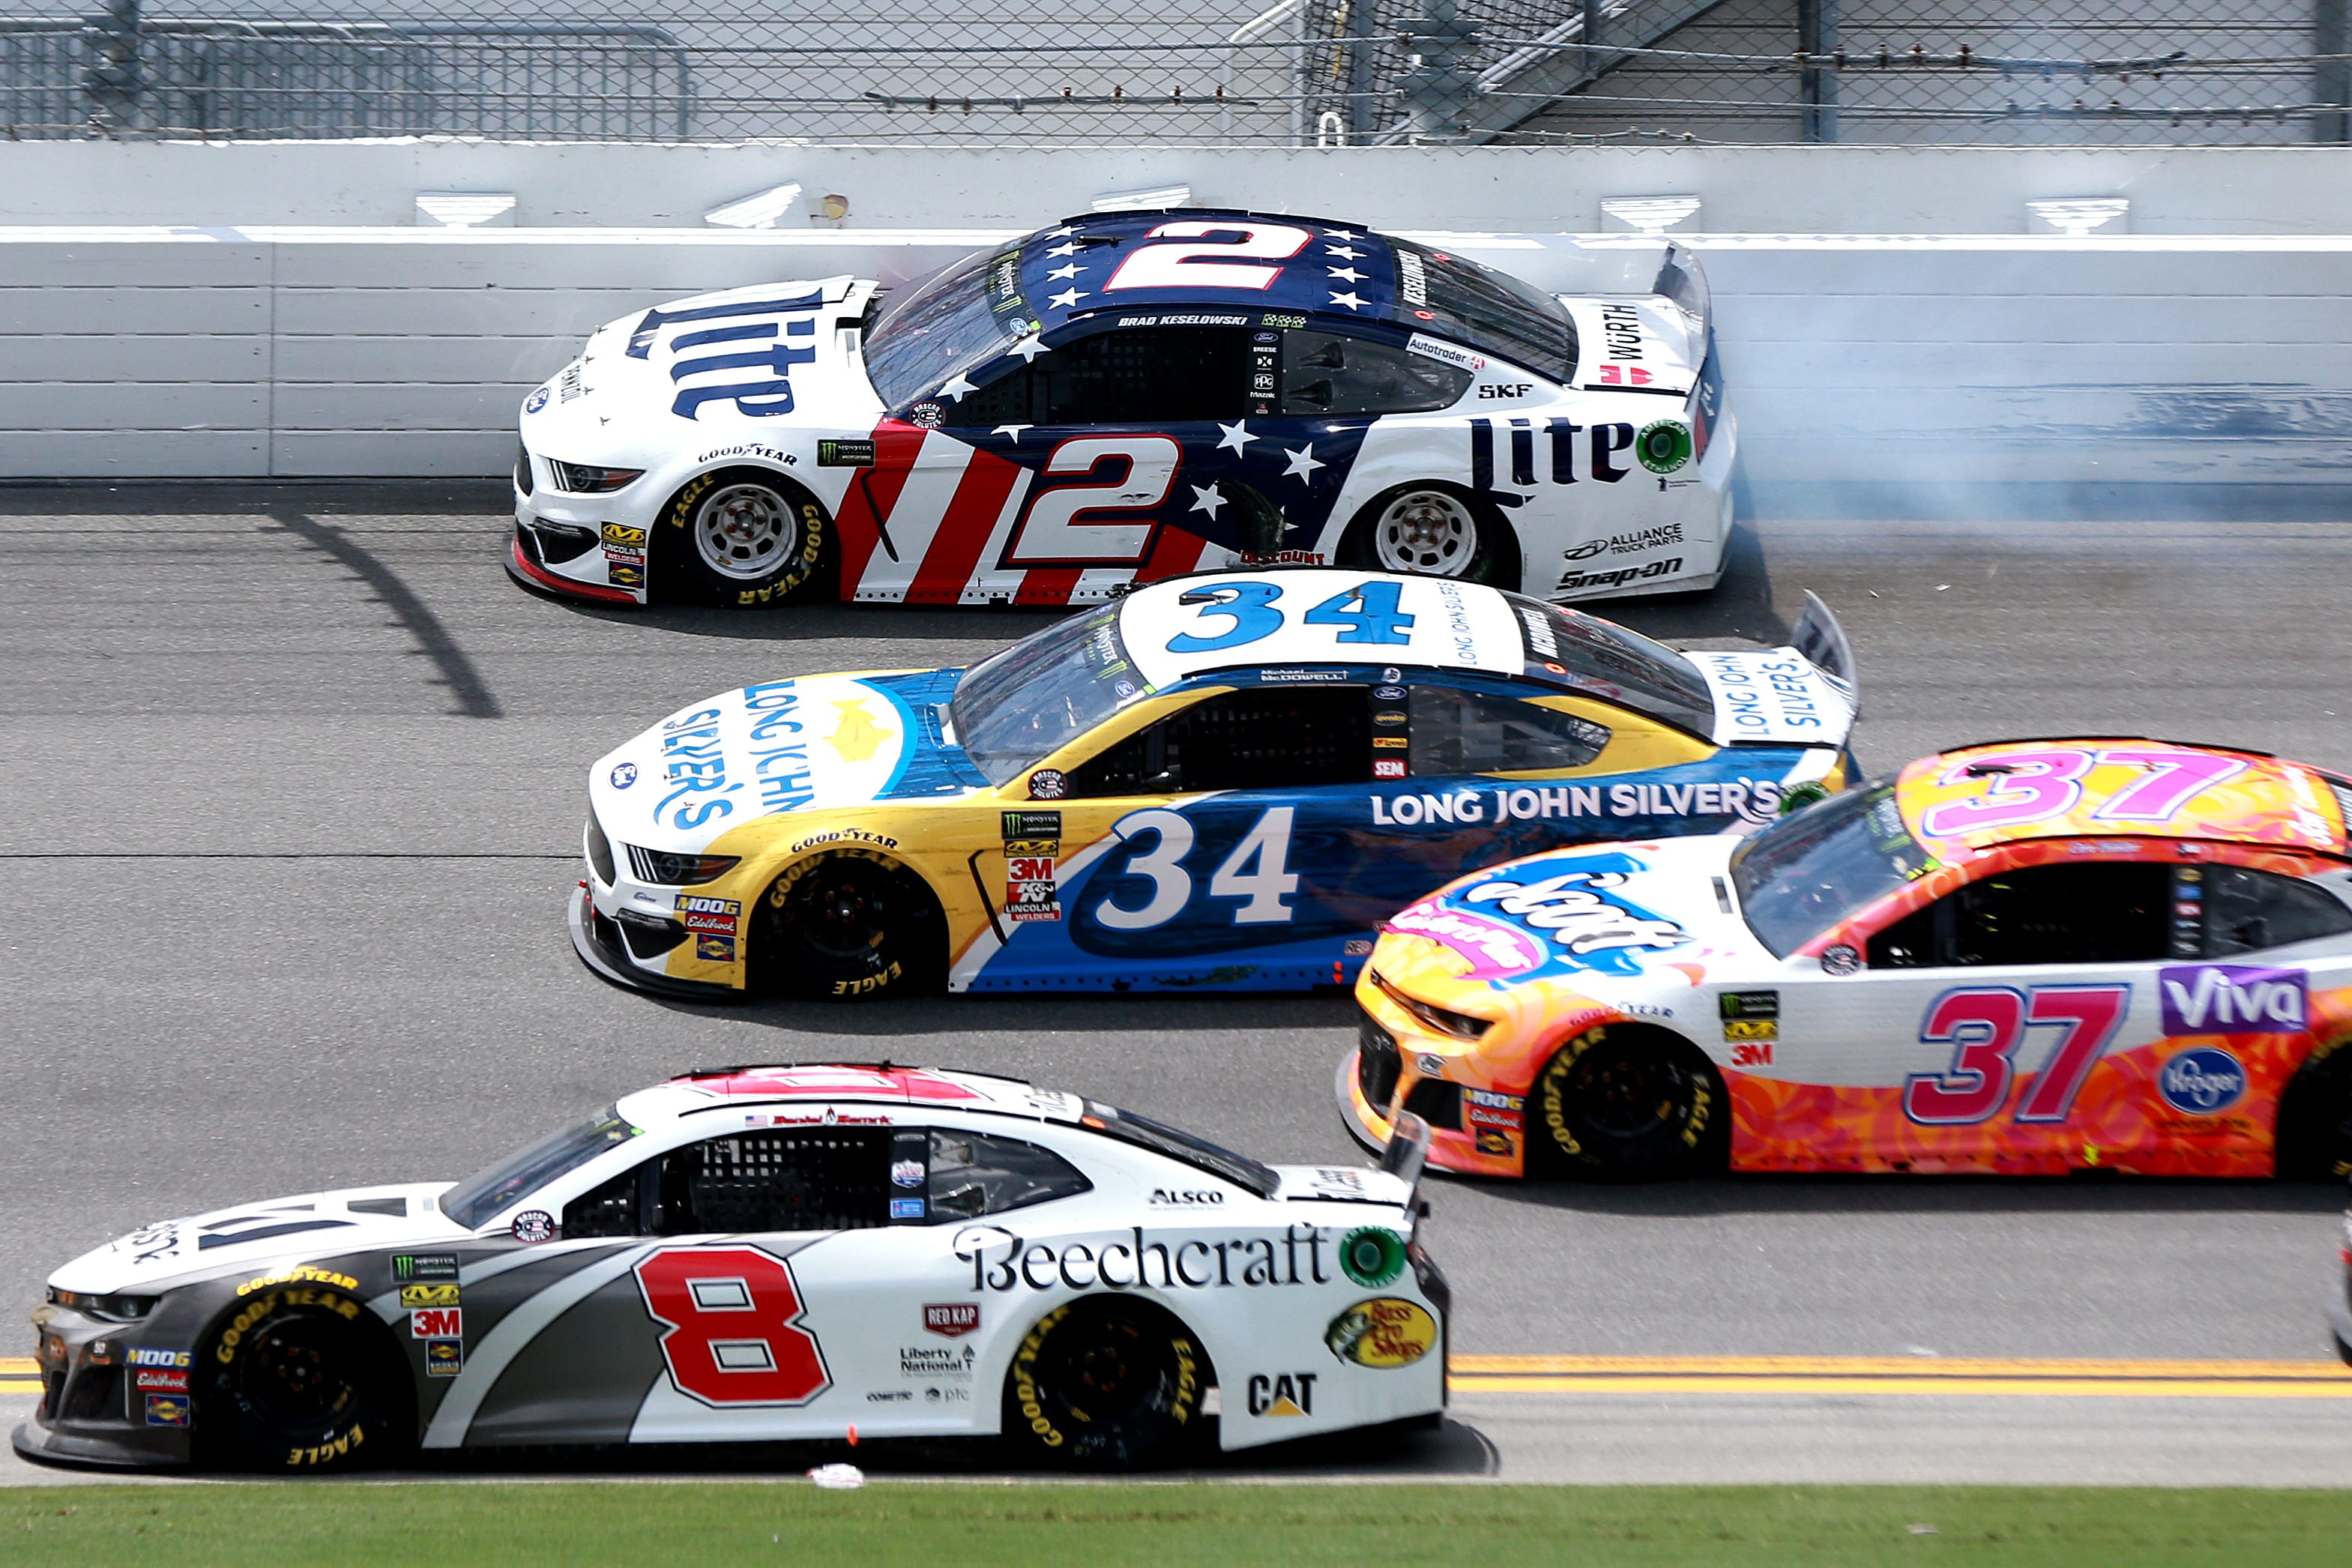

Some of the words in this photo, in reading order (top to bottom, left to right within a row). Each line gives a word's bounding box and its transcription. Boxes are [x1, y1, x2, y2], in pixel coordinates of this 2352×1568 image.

[1103, 220, 1314, 292] 2
[1397, 249, 1426, 307] KESELOWSKI
[1118, 316, 1157, 327] BRAD
[1160, 315, 1249, 325] KESELOWSKI
[1409, 339, 1467, 363] Autotrader
[1255, 376, 1273, 388] PPG
[1478, 383, 1534, 399] SKF
[913, 403, 941, 414] NASCAR
[912, 419, 941, 429] SALUTES
[1641, 419, 1686, 438] AMERICAN
[1642, 455, 1689, 474] ETHANOL
[672, 471, 715, 529] EAGLE
[1004, 433, 1183, 564] 2
[1611, 523, 1682, 546] ALLIANCE
[1611, 541, 1646, 555] TRUCK
[1649, 534, 1683, 549] PARTS
[603, 543, 636, 555] LINCOLN
[1240, 549, 1324, 565] DCOUNT
[1555, 557, 1683, 591] Snap-on
[1166, 580, 1415, 654] 34
[1094, 624, 1118, 665] MONSTER
[1455, 637, 1477, 666] LONG
[1708, 655, 1757, 688] JOHN
[1757, 663, 1821, 727] SILVER'S
[744, 680, 804, 741] LONG
[1726, 692, 1770, 735] LONG
[654, 708, 745, 830] SILVER'S
[1033, 771, 1061, 783] NASCAR
[1375, 761, 1405, 777] SEM
[1371, 792, 1484, 825] LONG
[1495, 786, 1601, 823] JOHN
[1610, 777, 1782, 824] SILVER'S
[1923, 749, 2250, 837] 37
[1010, 858, 1052, 880] 3M
[1095, 805, 1300, 931] 34
[676, 896, 740, 914] MOOG
[1005, 904, 1050, 913] LINCOLN
[1015, 912, 1055, 920] WELDERS
[687, 915, 735, 932] Edelbrock
[832, 960, 902, 995] EAGLE
[2162, 967, 2304, 1028] Viva
[1731, 1044, 1773, 1067] 3M
[1904, 983, 2132, 1125] 37
[2166, 1056, 2241, 1107] Kroger
[953, 1222, 1330, 1292] Beechcraft
[414, 1309, 459, 1337] 3M
[927, 1307, 950, 1325] RED
[951, 1306, 975, 1324] KAP
[1371, 1300, 1412, 1322] Bass
[631, 1242, 834, 1409] 8
[126, 1348, 192, 1367] MOOG
[899, 1348, 952, 1360] Liberty
[900, 1360, 962, 1372] National
[1248, 1373, 1317, 1417] CAT
[286, 1422, 365, 1465] EAGLE
